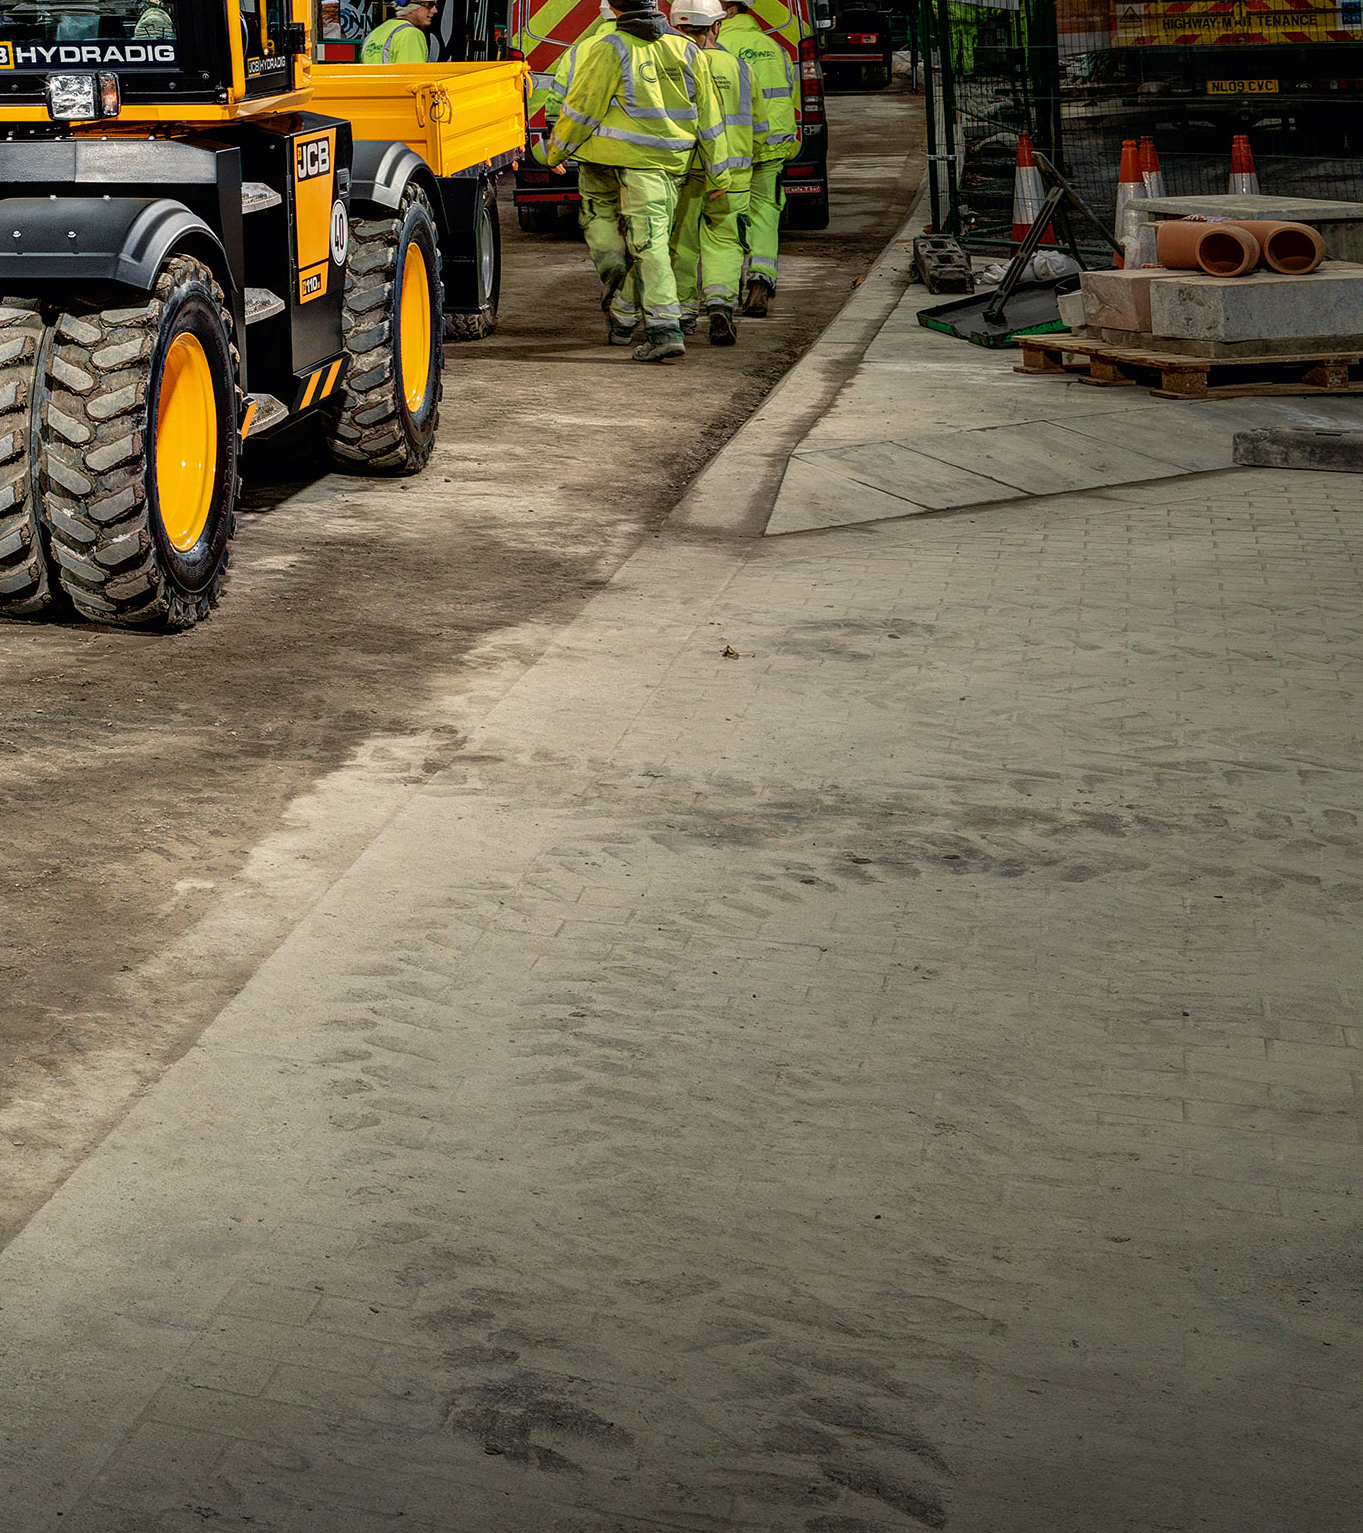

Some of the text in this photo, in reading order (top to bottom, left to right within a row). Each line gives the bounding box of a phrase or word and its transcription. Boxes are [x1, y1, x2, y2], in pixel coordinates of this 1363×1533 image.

[16, 45, 175, 63] HYDRADIG
[248, 56, 286, 74] JCB HYDRADIG
[1212, 80, 1273, 92] NL09 CVC
[297, 140, 330, 179] JCB
[335, 213, 344, 252] 40
